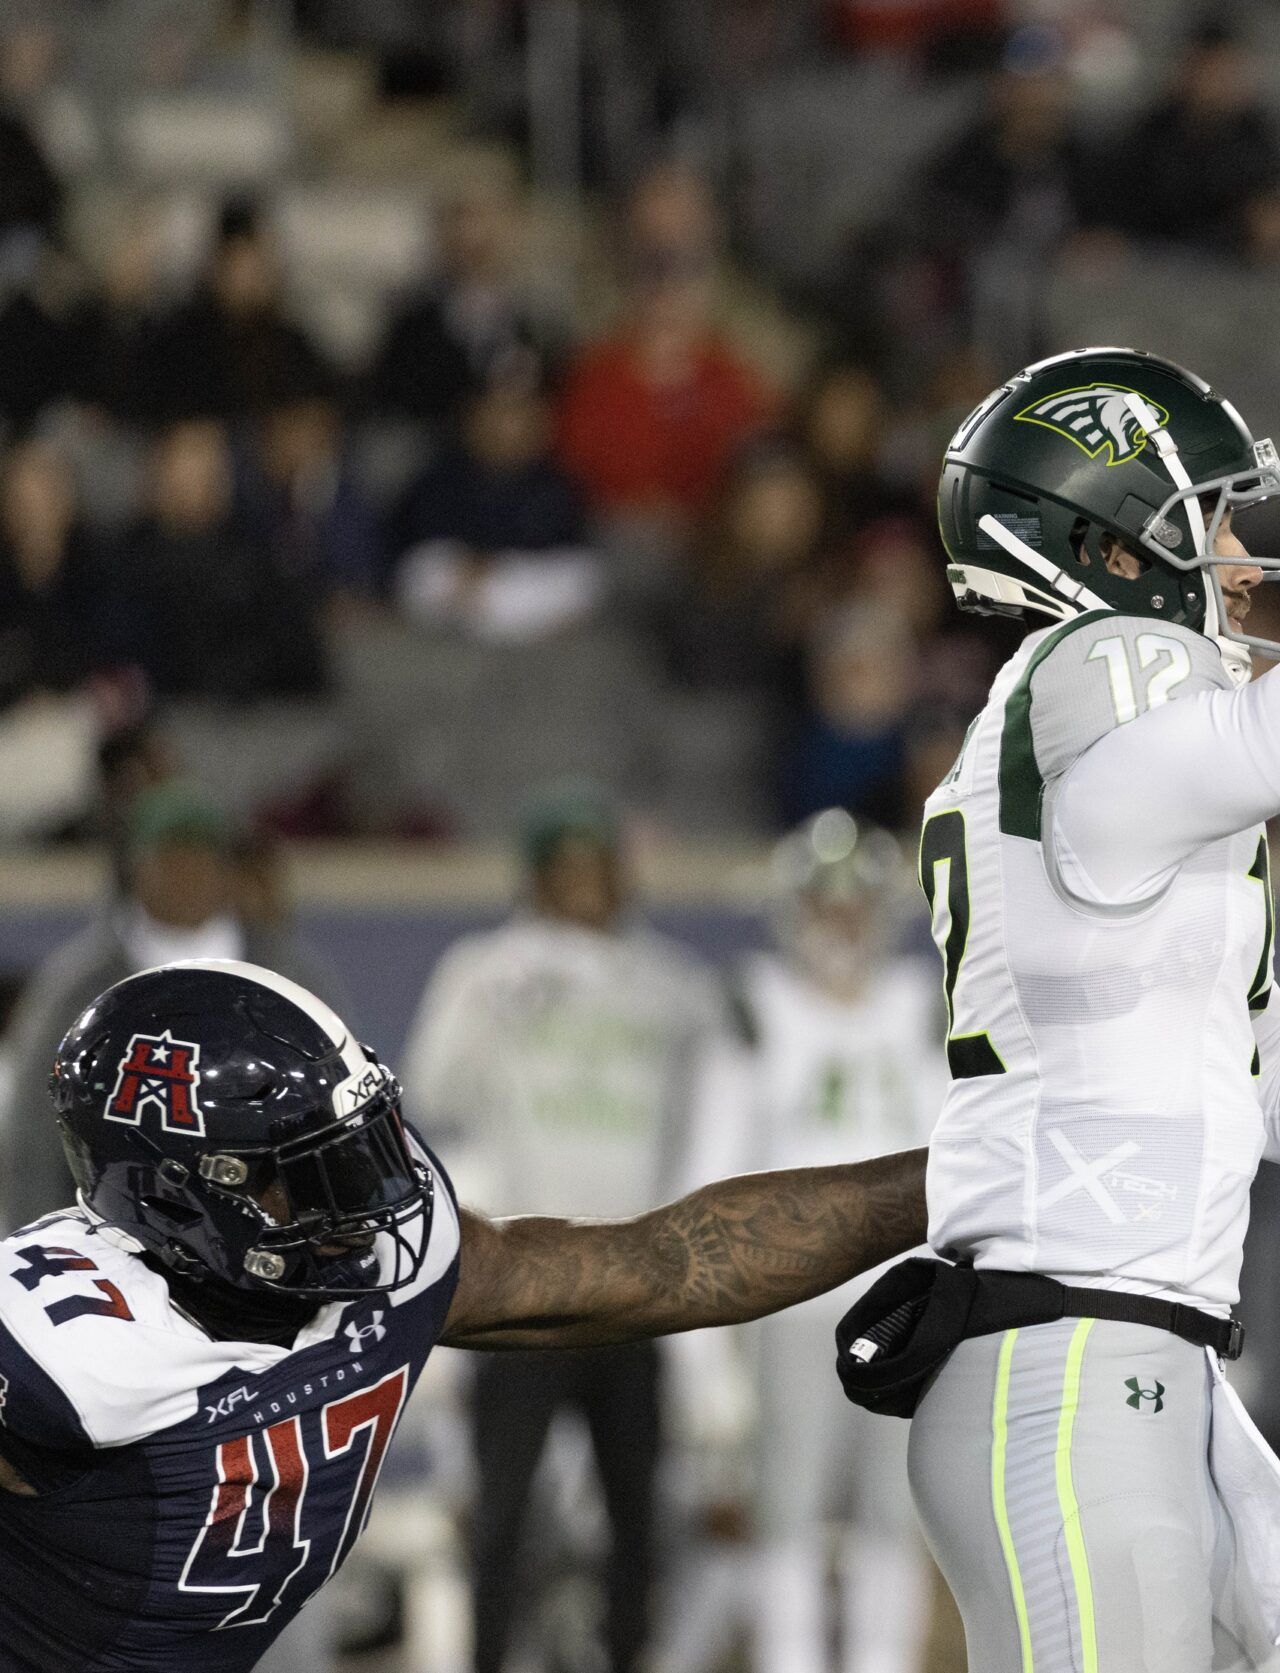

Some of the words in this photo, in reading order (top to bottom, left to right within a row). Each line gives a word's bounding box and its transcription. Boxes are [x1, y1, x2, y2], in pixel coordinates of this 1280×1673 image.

[1084, 632, 1193, 726] 12
[346, 1070, 386, 1108] XFL
[9, 1244, 137, 1327] 47
[204, 1385, 260, 1424] XFL
[253, 1361, 363, 1424] HOUSTON
[178, 1362, 411, 1632] 47
